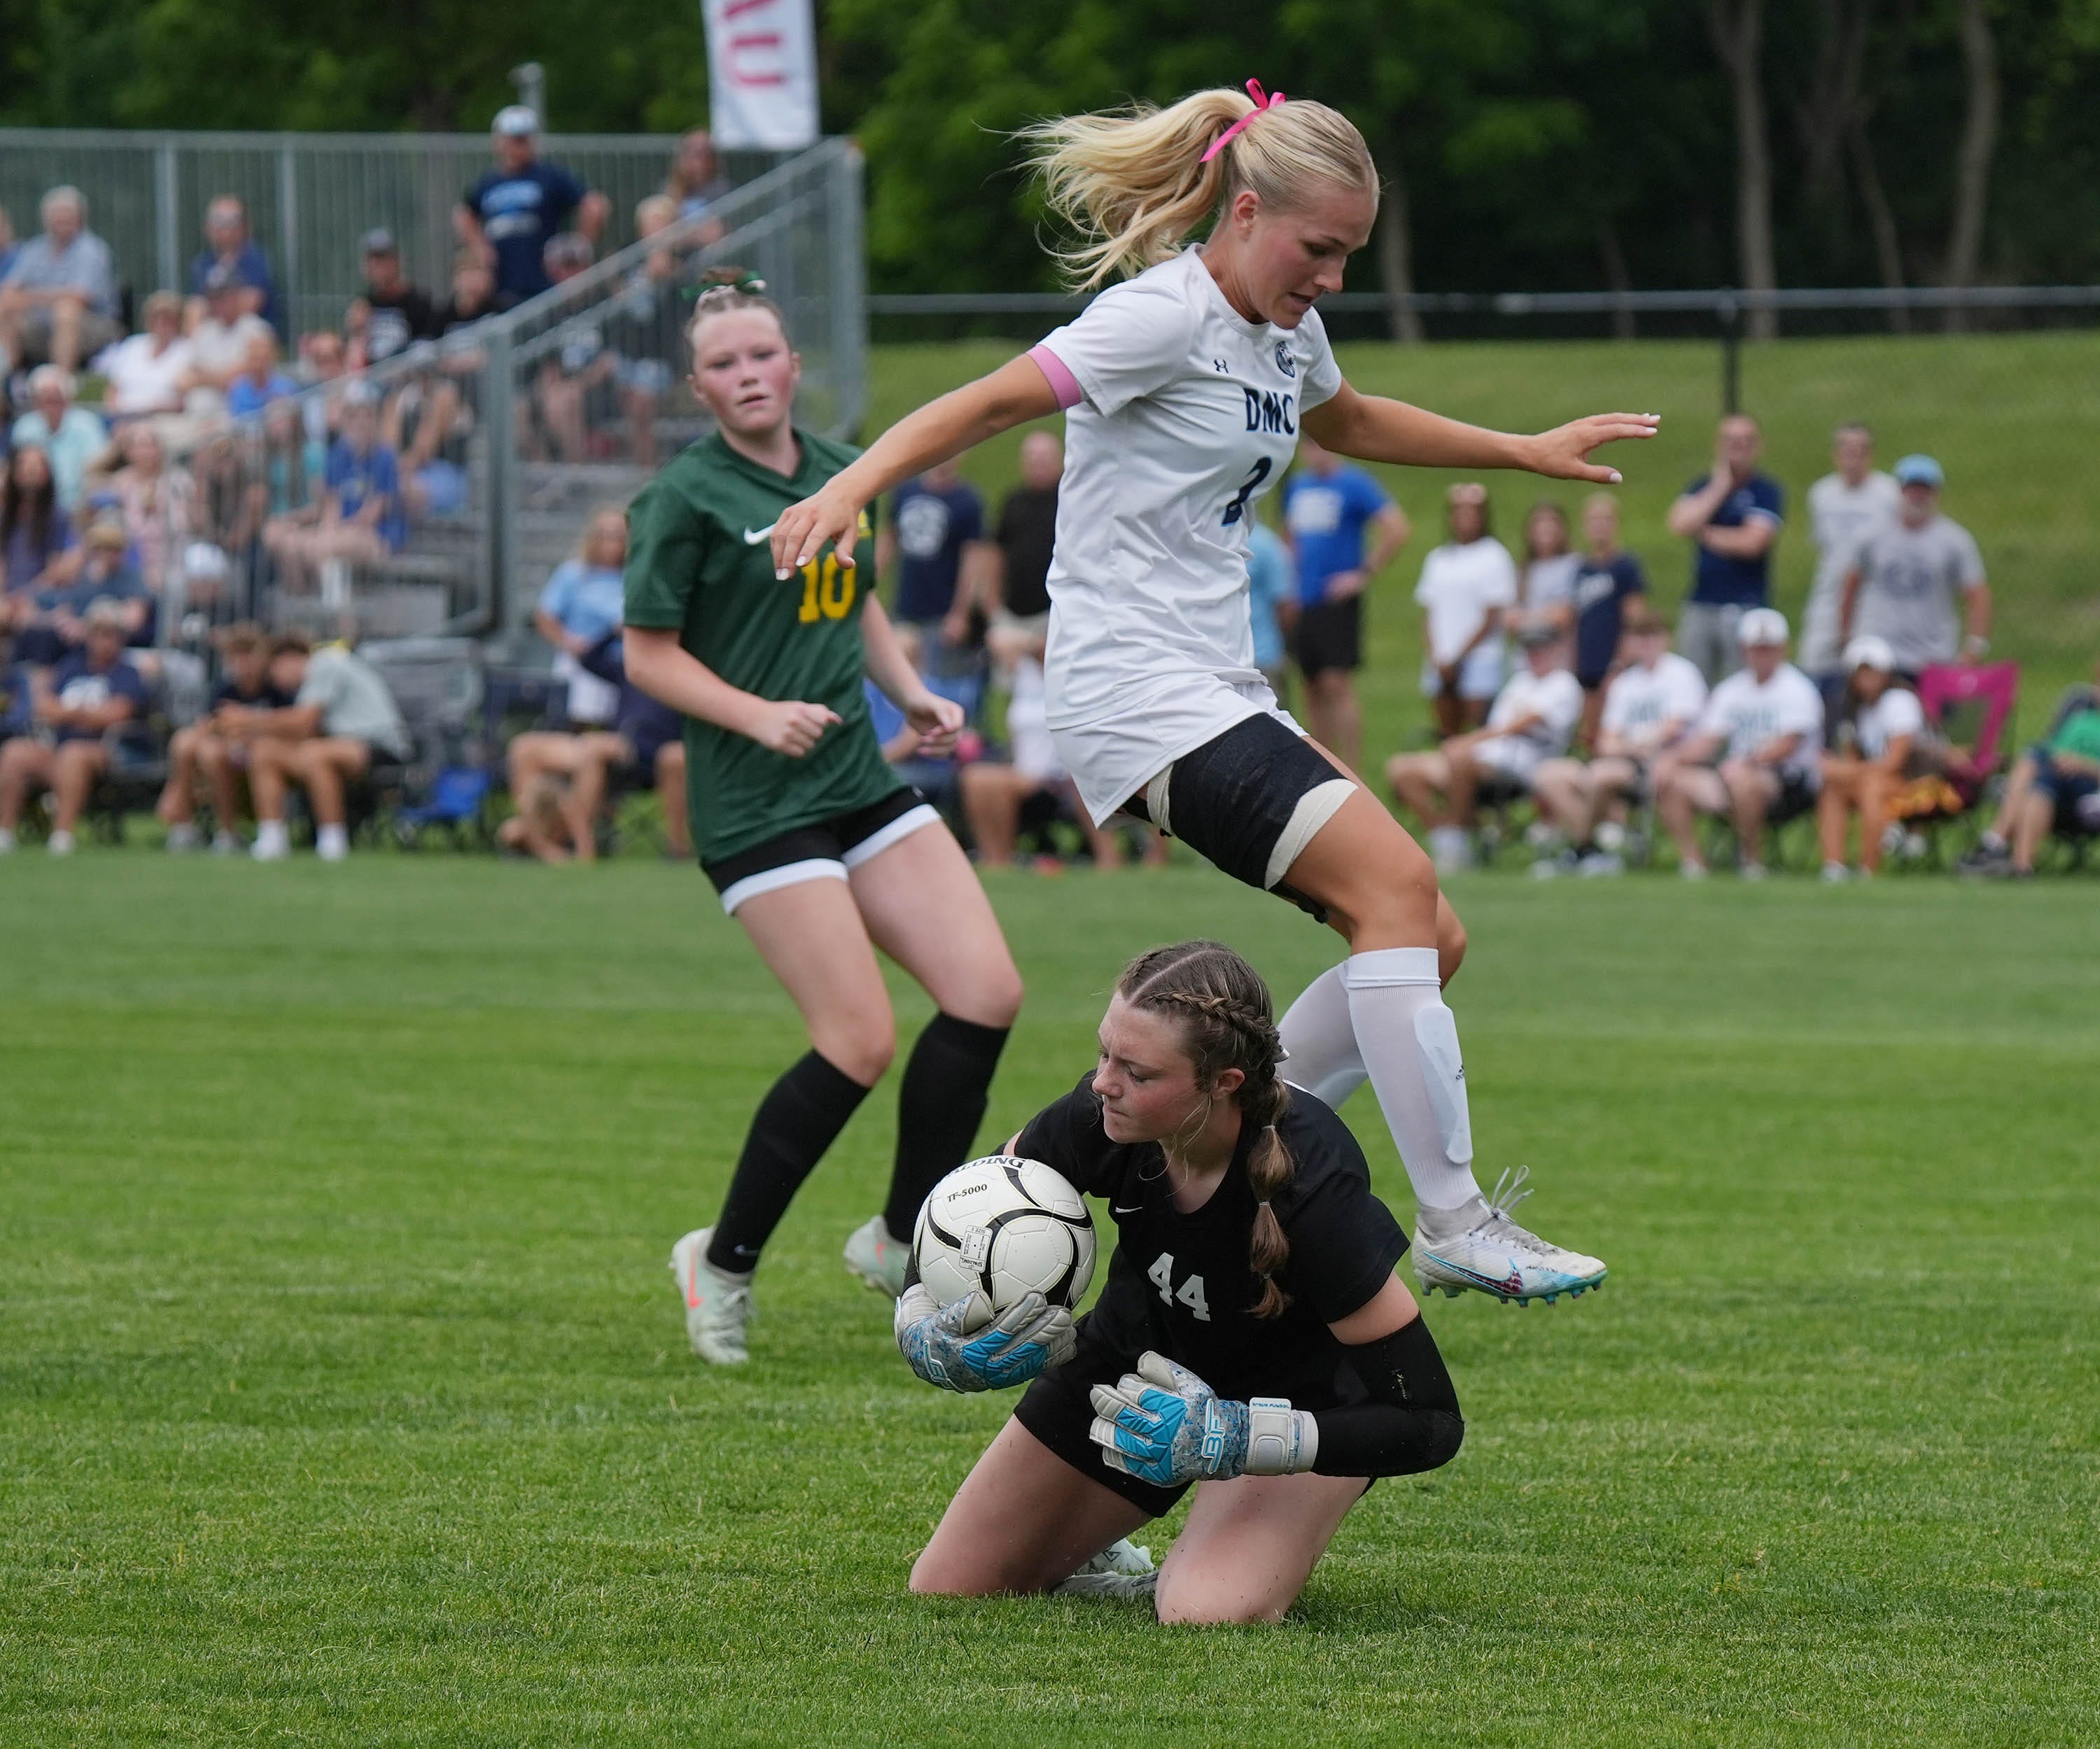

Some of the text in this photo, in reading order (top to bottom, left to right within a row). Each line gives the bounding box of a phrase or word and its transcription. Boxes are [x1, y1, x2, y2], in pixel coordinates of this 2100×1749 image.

[1243, 388, 1295, 435] DMC
[1221, 456, 1272, 526] 2
[799, 552, 855, 623] 10
[946, 1183, 988, 1203] TF-5000
[1147, 1251, 1211, 1322] 44
